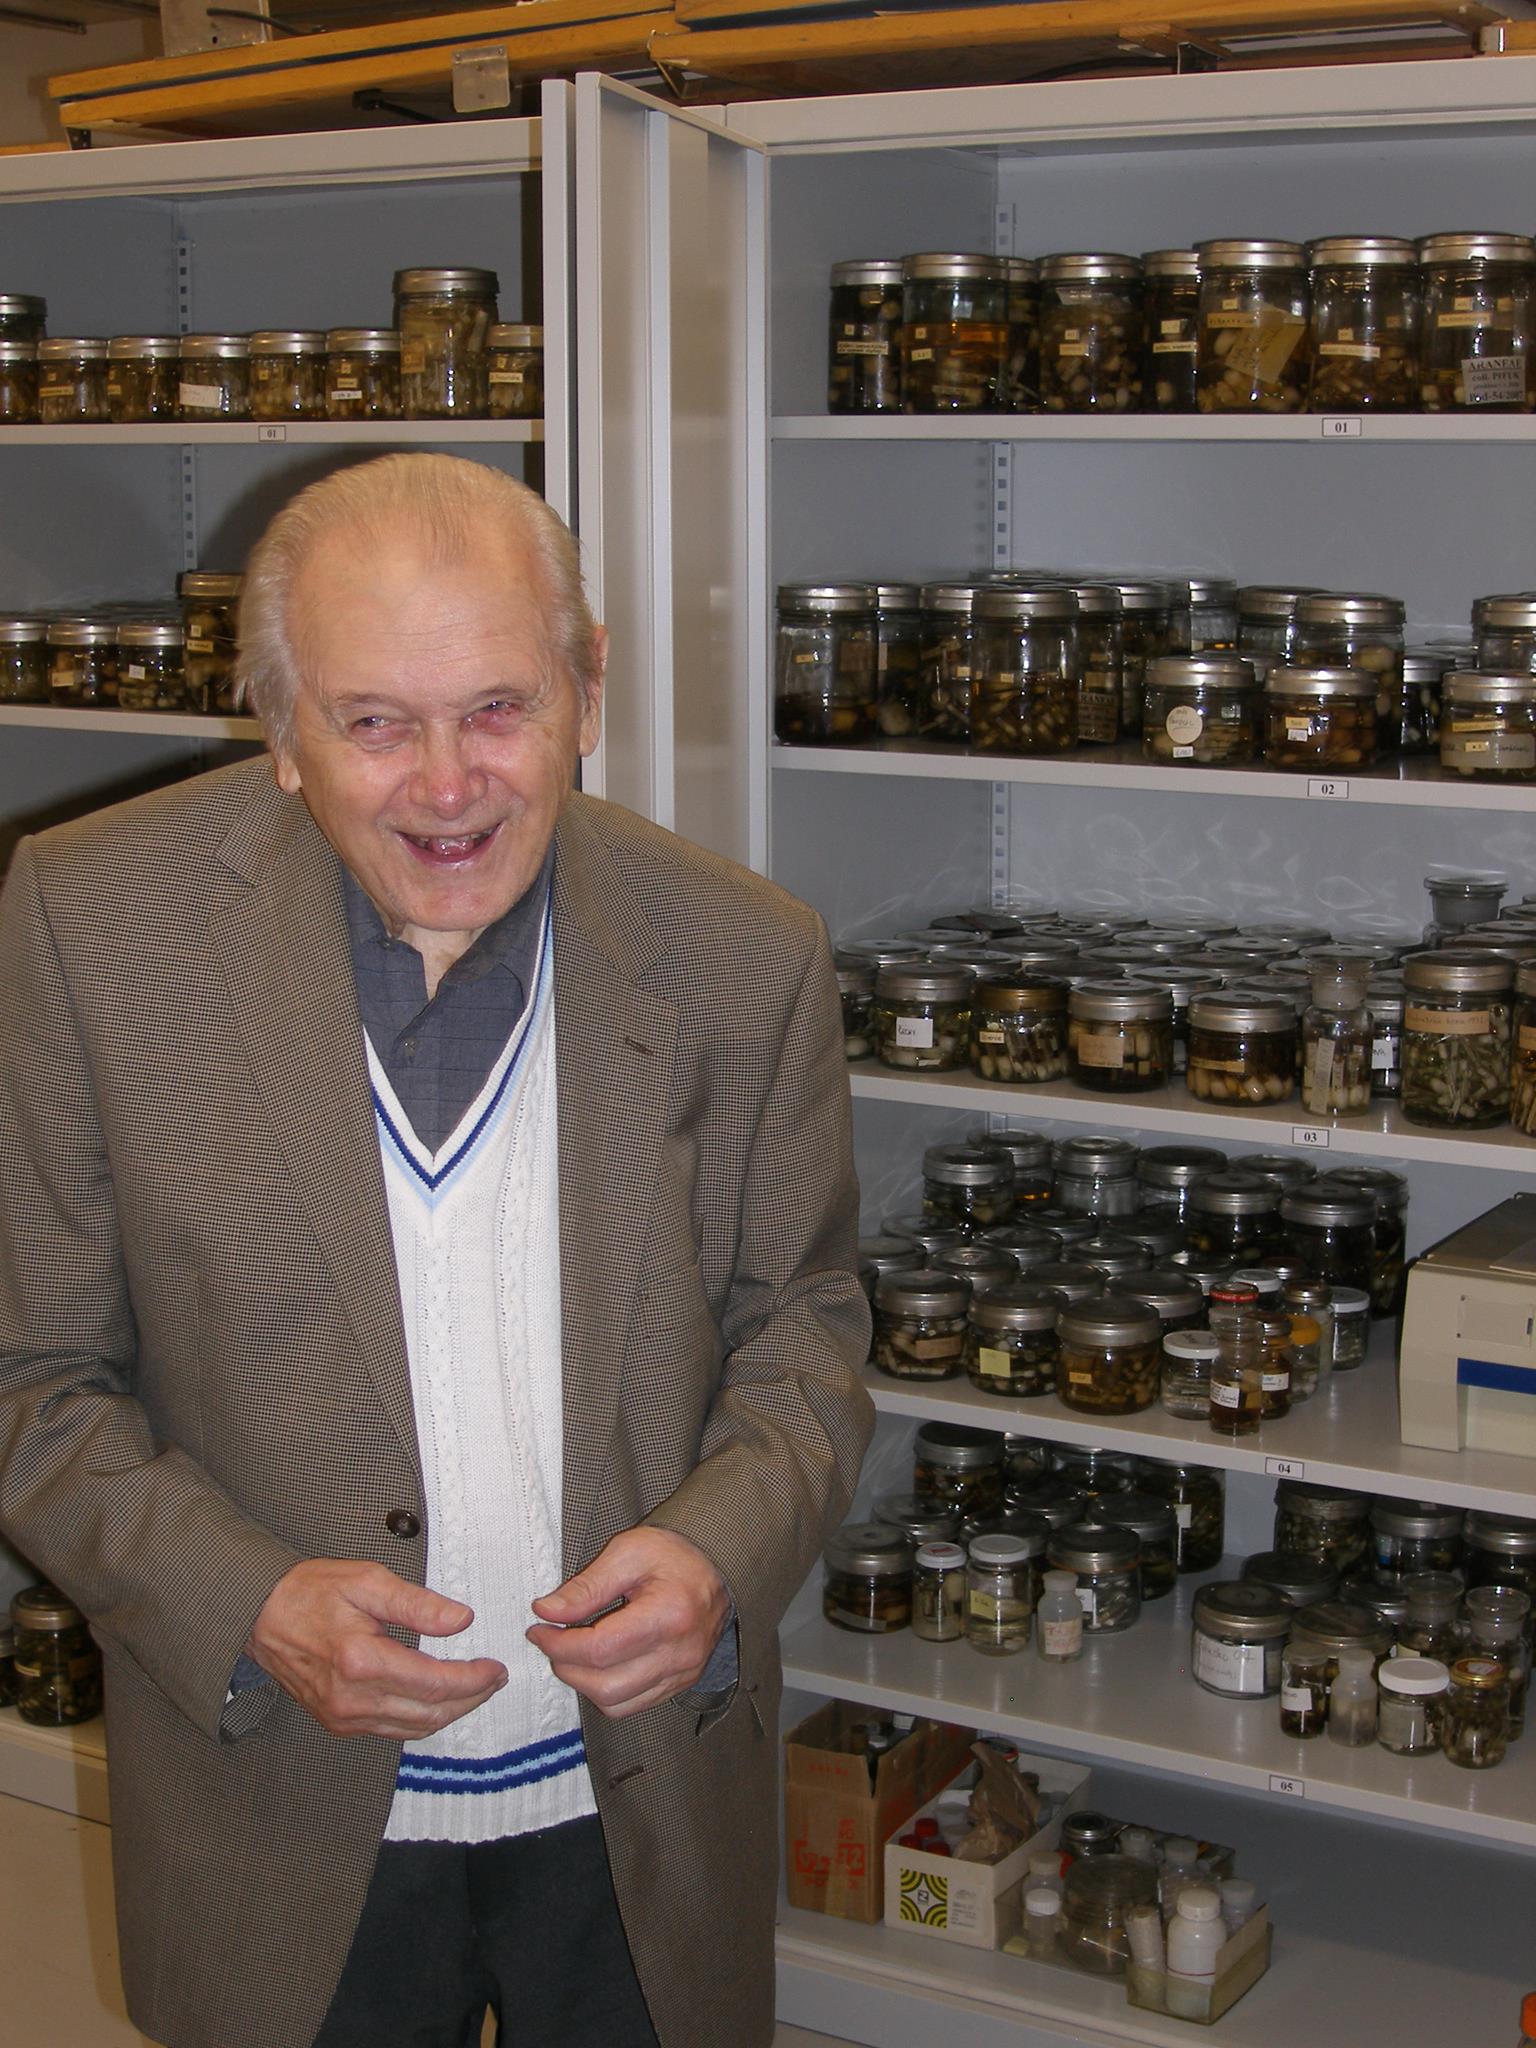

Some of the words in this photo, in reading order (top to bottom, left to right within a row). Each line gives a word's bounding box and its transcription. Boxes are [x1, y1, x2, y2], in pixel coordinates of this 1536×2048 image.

[266, 429, 276, 438] 01
[1334, 422, 1348, 434] 01
[1321, 784, 1335, 795] 02
[1303, 1132, 1317, 1143] 03
[1278, 1463, 1291, 1474] 04
[1280, 1781, 1293, 1792] 05
